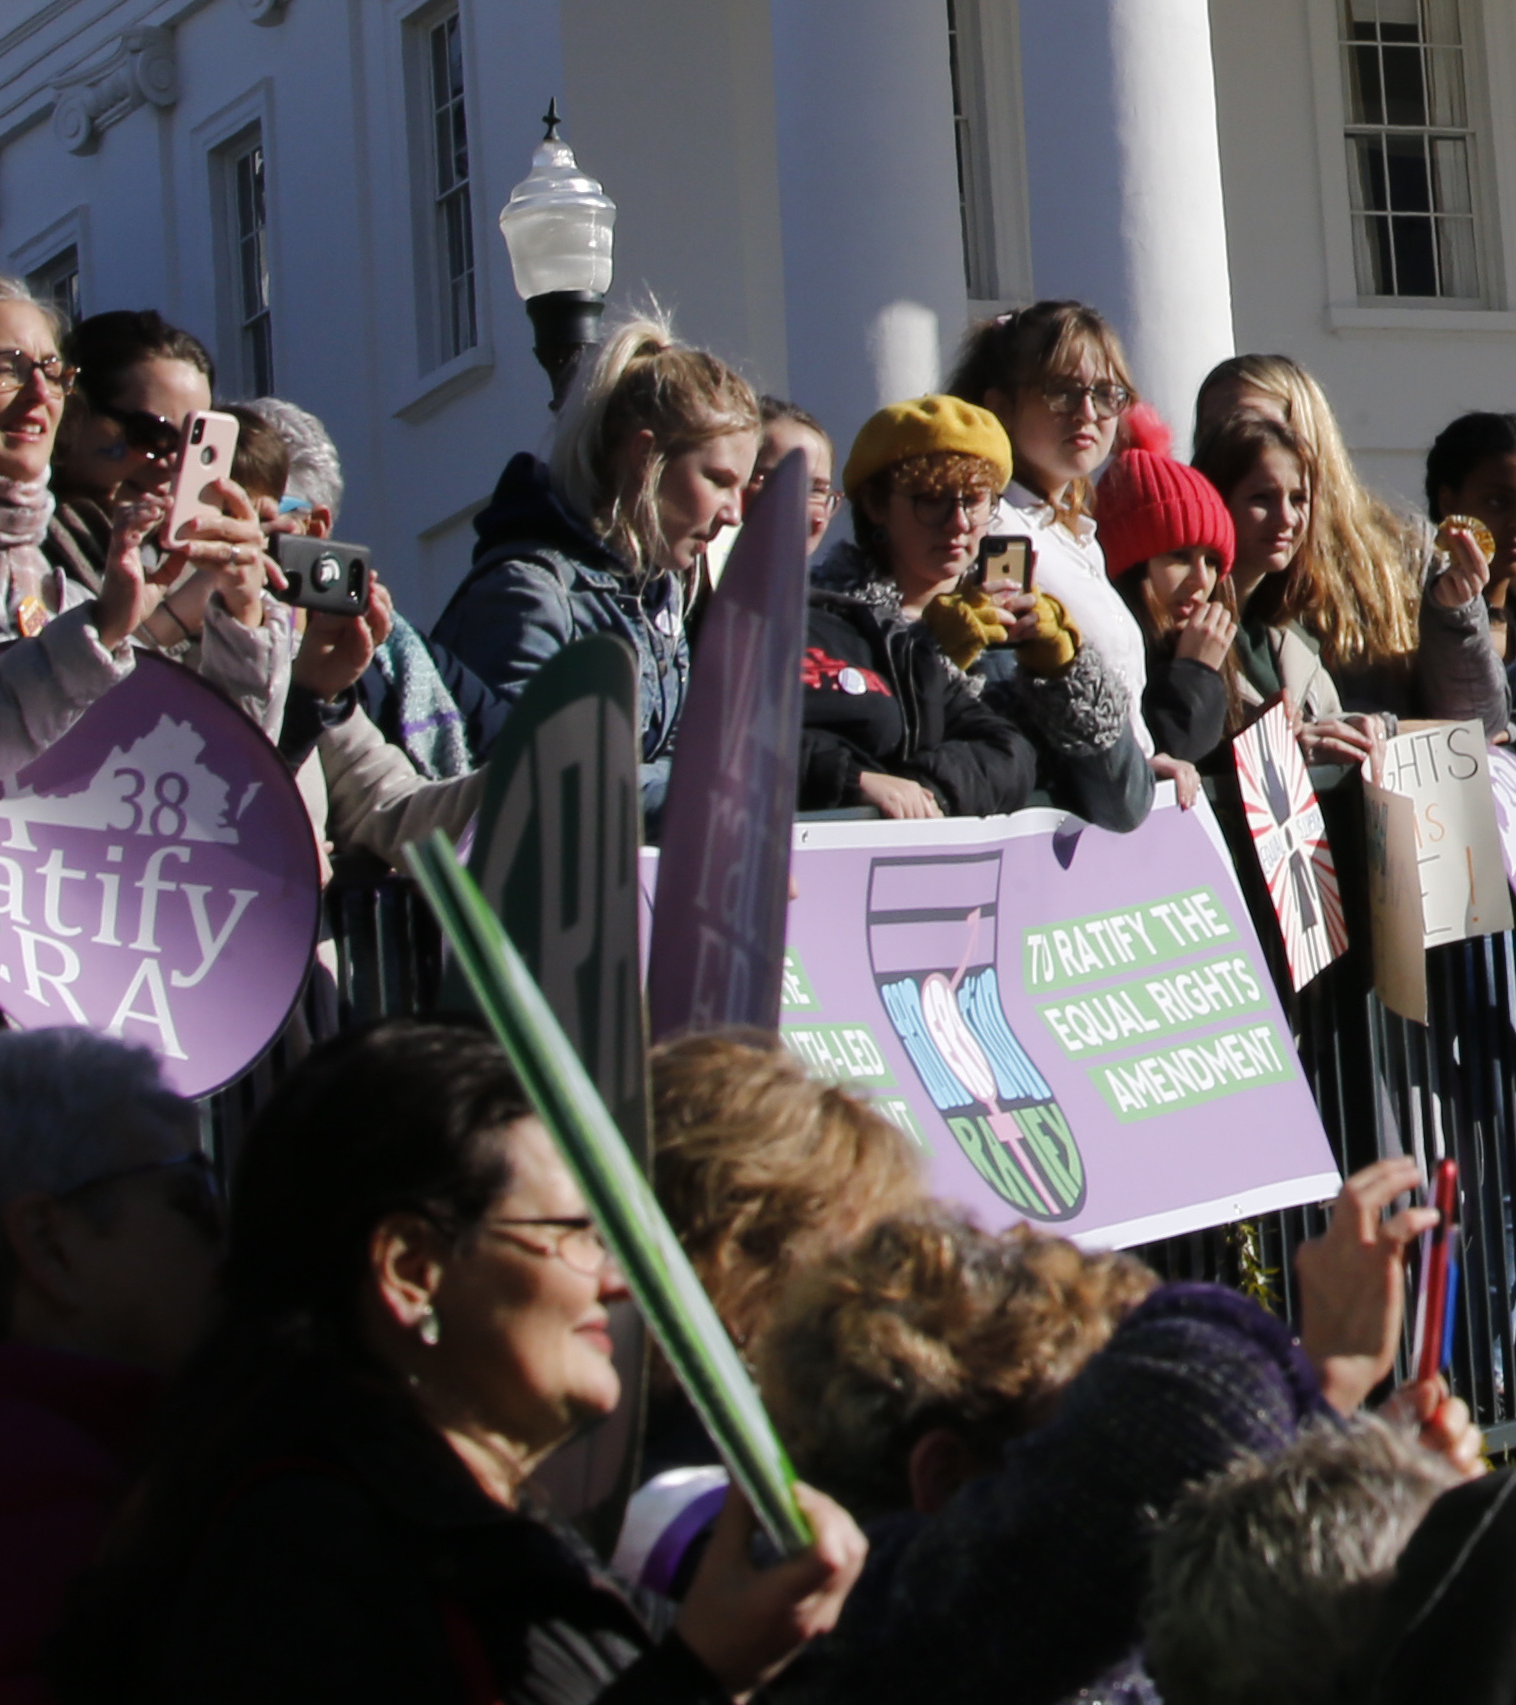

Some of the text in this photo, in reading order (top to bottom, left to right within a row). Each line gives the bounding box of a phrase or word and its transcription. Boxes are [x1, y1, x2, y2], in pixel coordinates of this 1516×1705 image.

[107, 767, 190, 841] 38
[0, 845, 259, 988] atify
[1053, 910, 1158, 978] RATIFY
[1149, 892, 1230, 947] THE
[0, 925, 188, 1061] RA
[1044, 958, 1261, 1052] EQUAL RIGHTS
[1104, 1026, 1284, 1113] AMENDMENT
